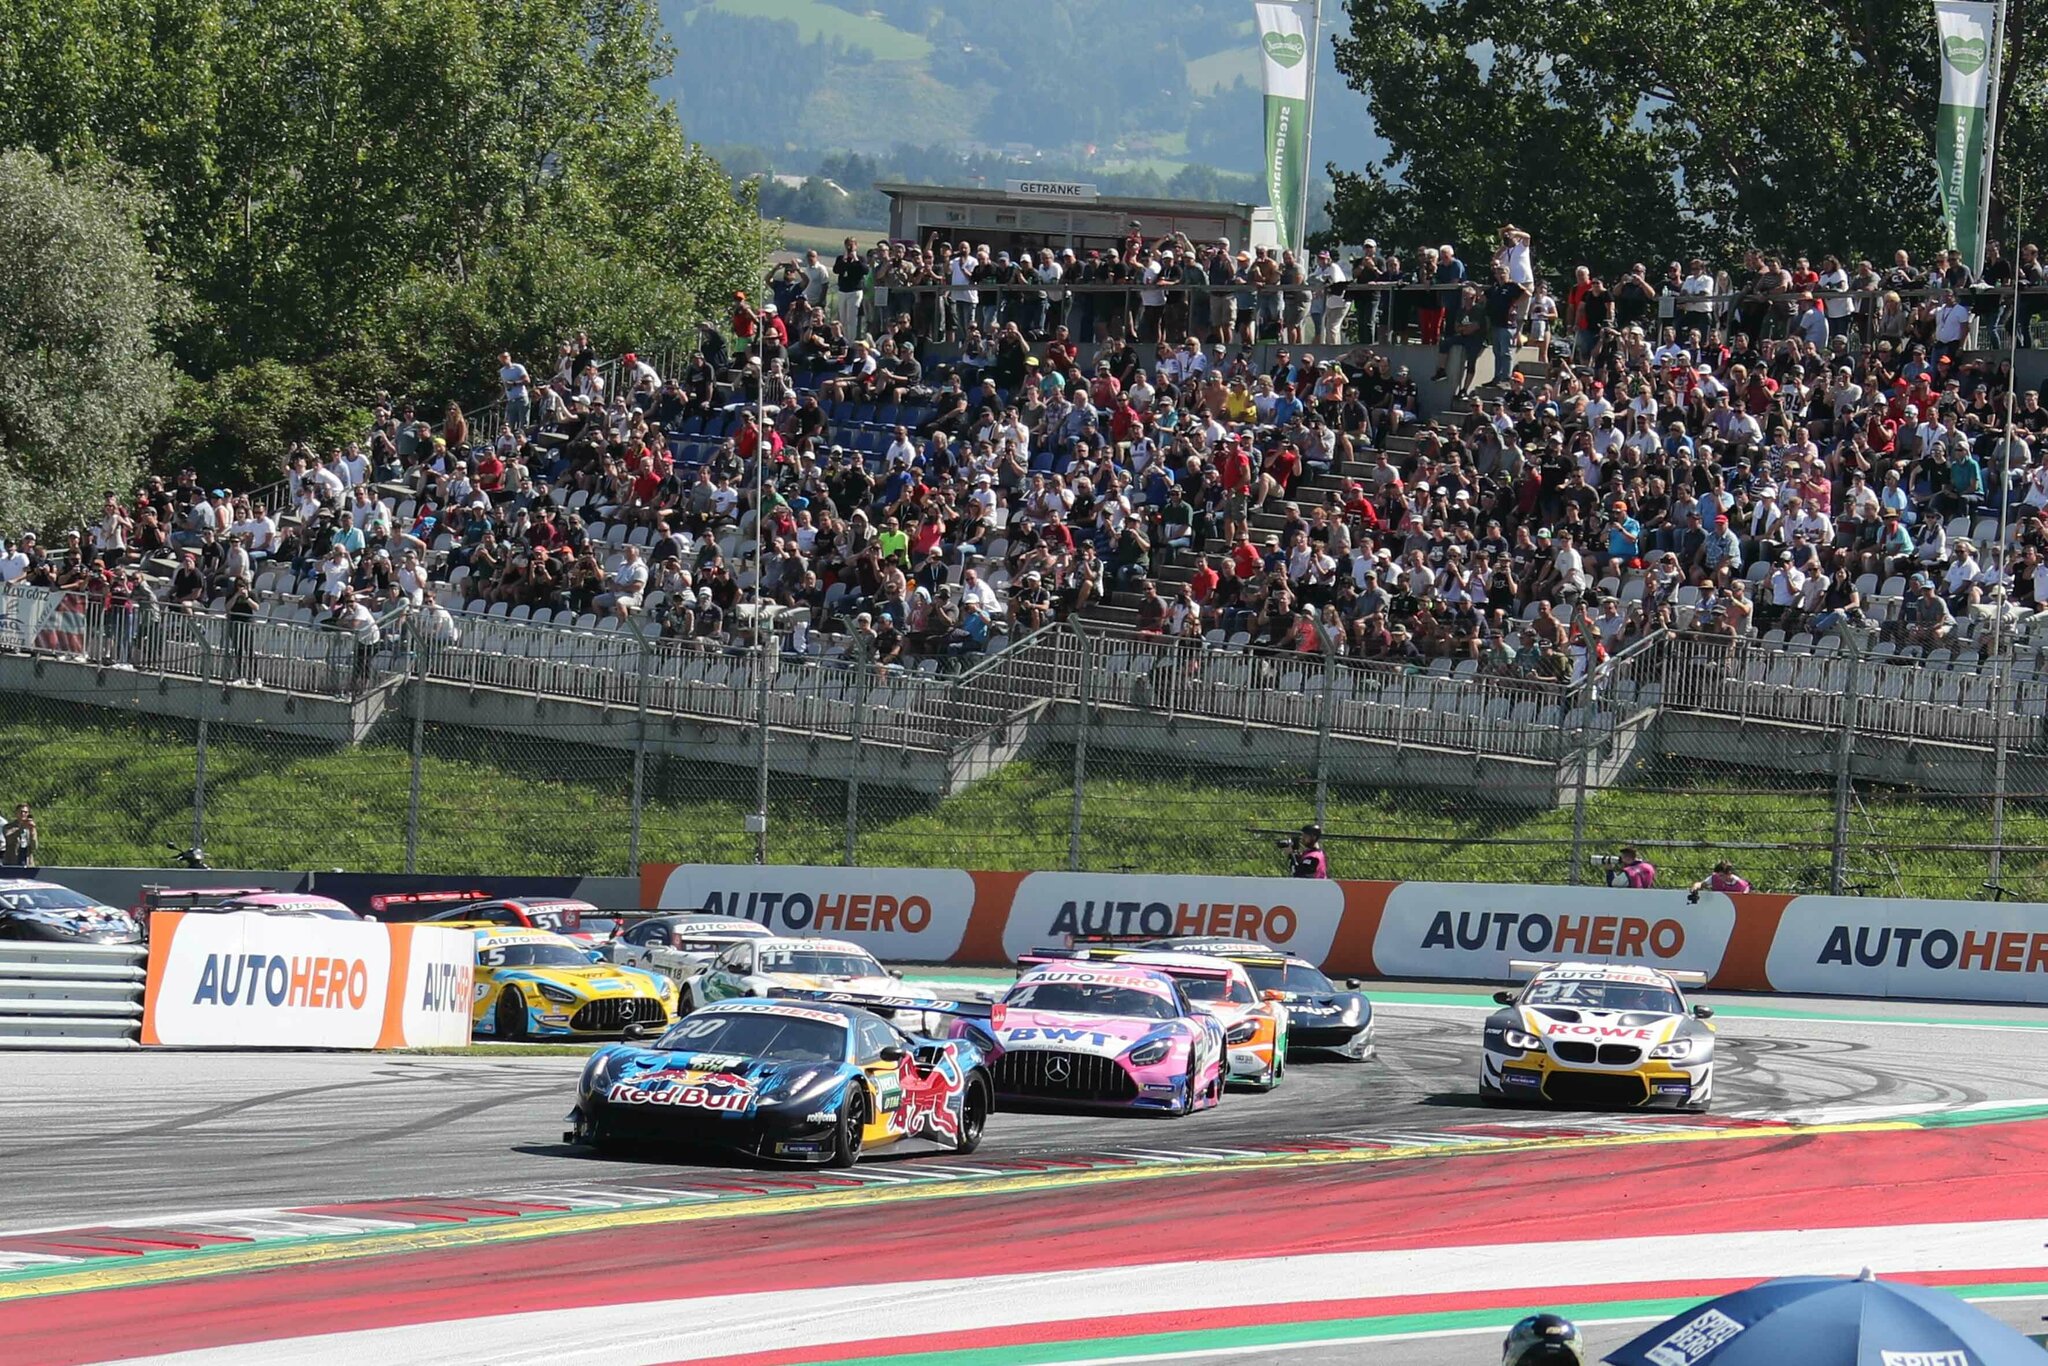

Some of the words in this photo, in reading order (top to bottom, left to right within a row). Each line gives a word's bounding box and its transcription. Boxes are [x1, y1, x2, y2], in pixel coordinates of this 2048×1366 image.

[1020, 182, 1081, 196] GETRÄNKE
[702, 891, 932, 933] AUTOHERO
[535, 913, 562, 930] 51
[1048, 901, 1297, 944] AUTOHERO
[1421, 911, 1685, 958] AUTOHERO
[488, 947, 506, 966] 5
[762, 952, 793, 965] 11
[193, 953, 368, 1010] AUTOHERO
[673, 968, 682, 980] 18
[1031, 973, 1160, 989] AUTOHERO
[1545, 972, 1664, 985] AUTOHERO
[477, 985, 483, 996] 5
[1008, 985, 1039, 1008] 4
[1535, 982, 1580, 998] 31
[703, 1005, 842, 1023] AUTOHERO
[1008, 1028, 1112, 1047] BWT
[1548, 1024, 1654, 1041] ROWE
[608, 1084, 675, 1105] Red
[677, 1086, 751, 1112] Bull
